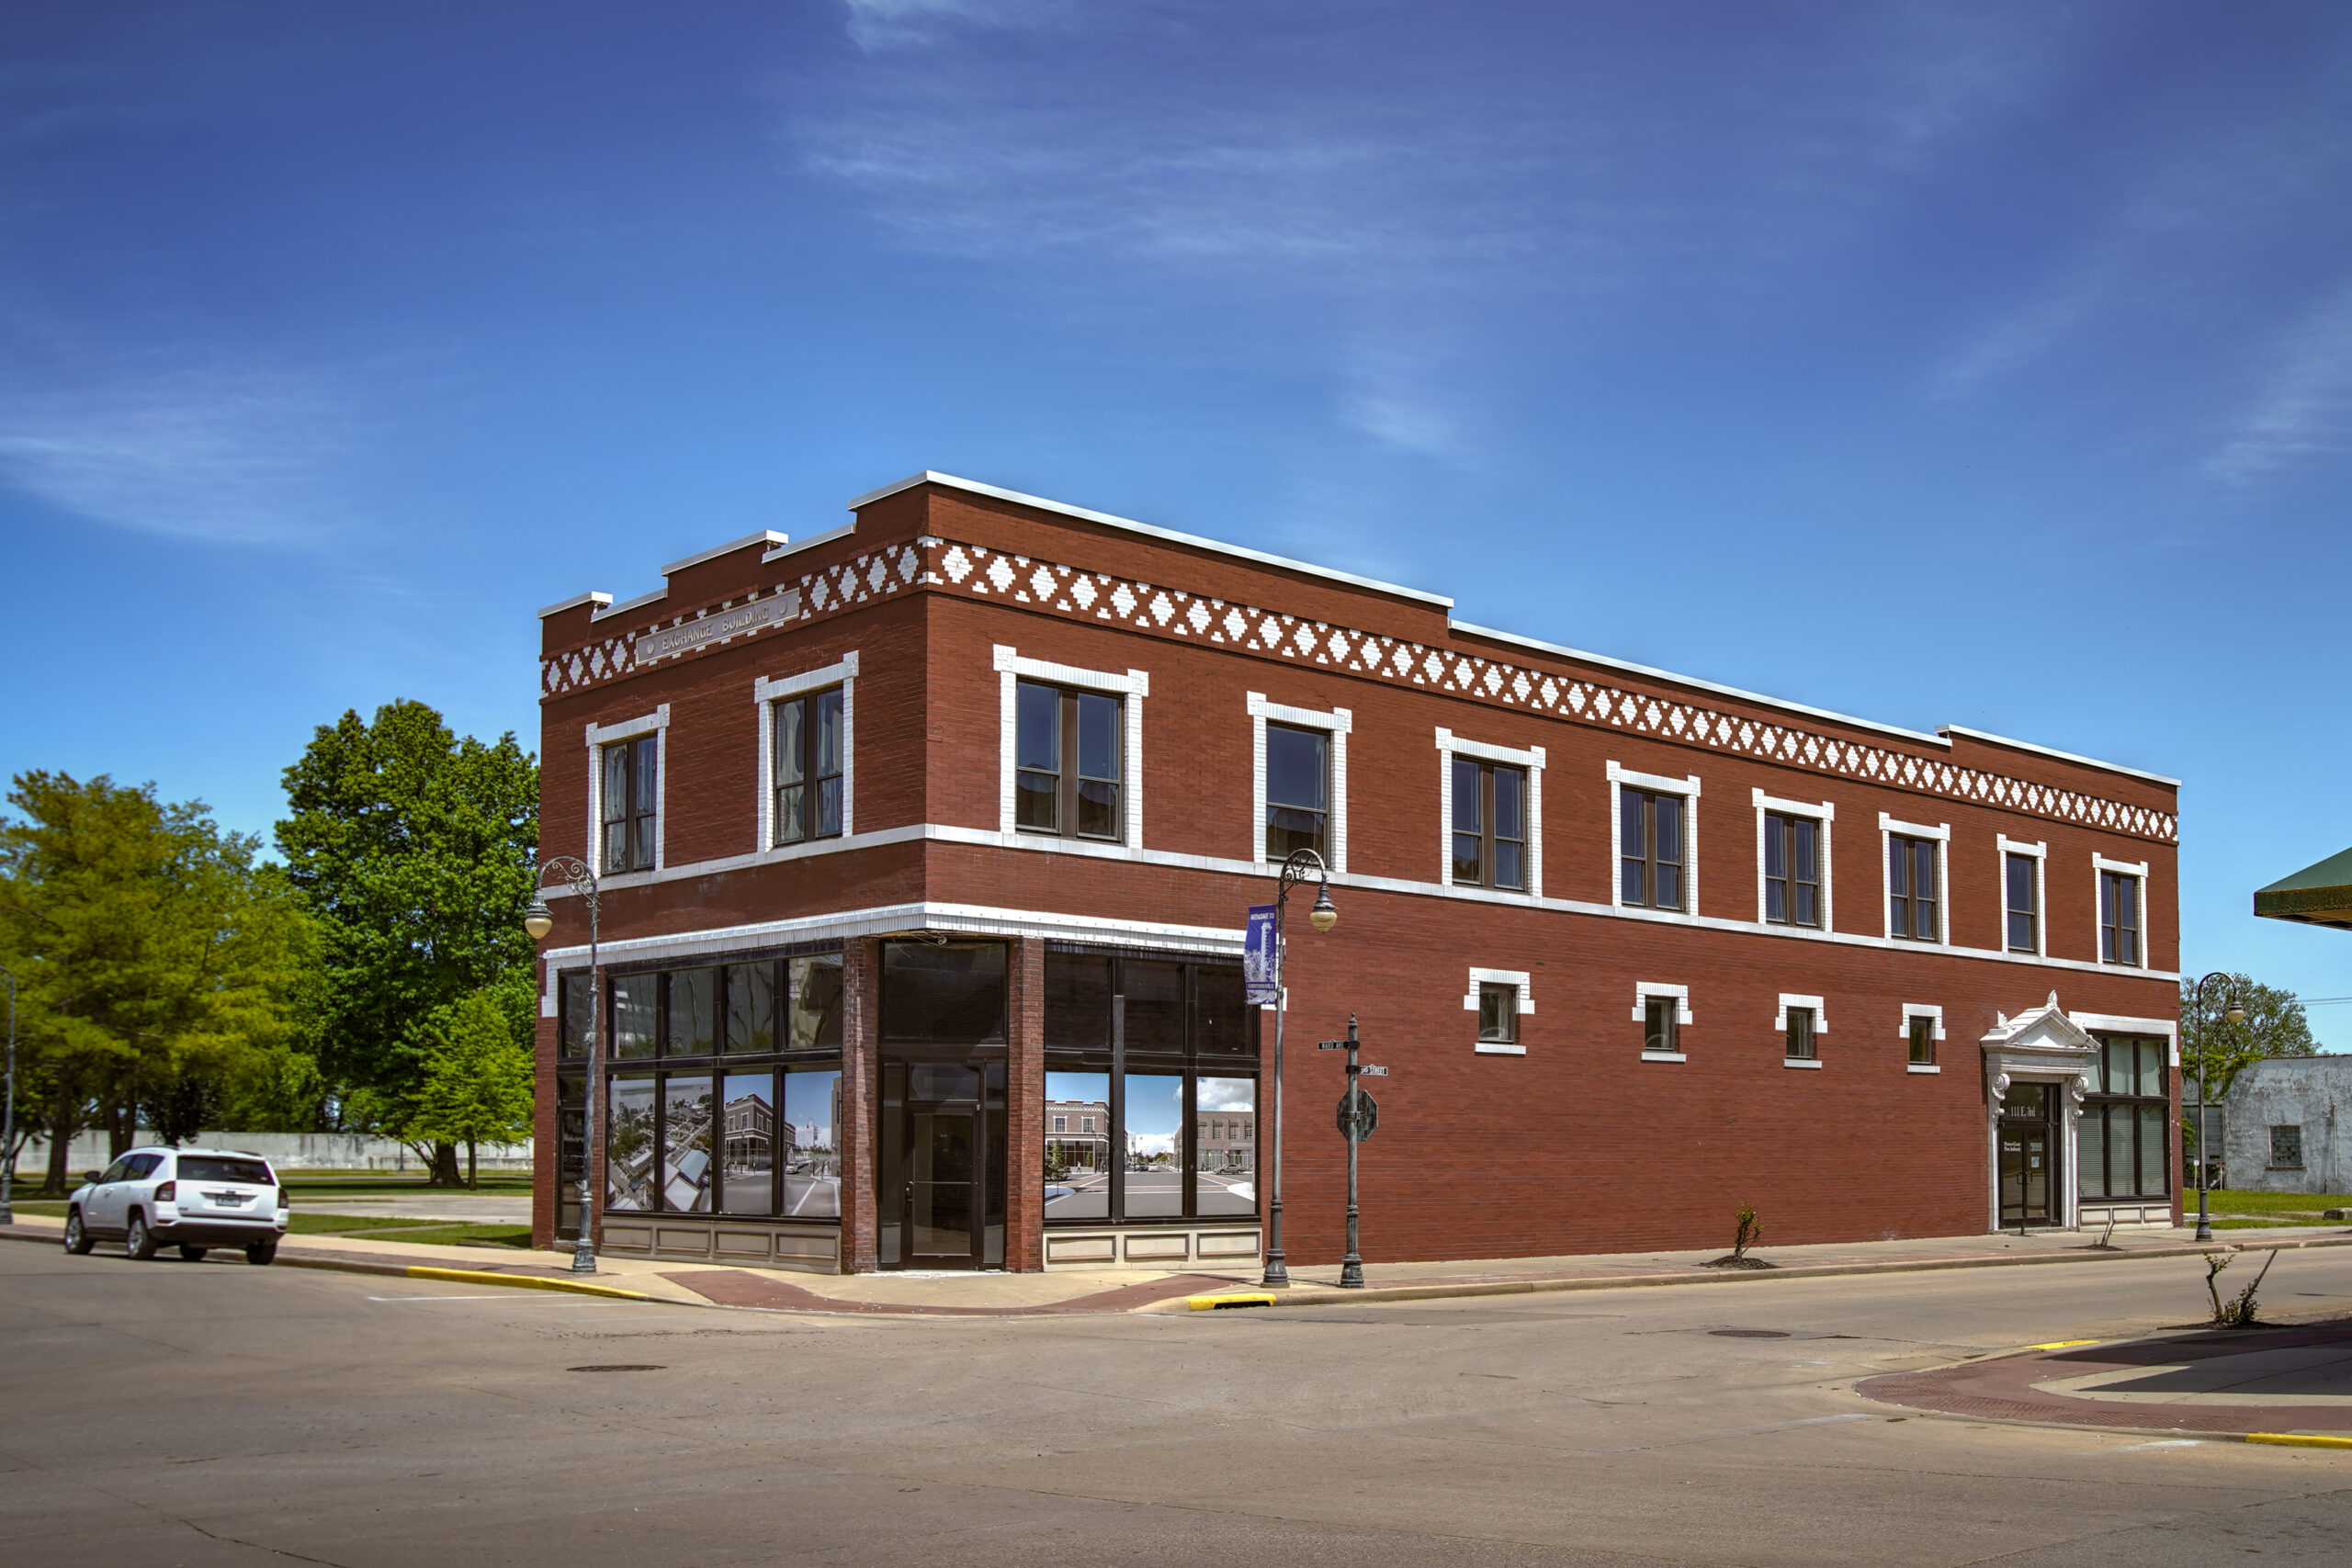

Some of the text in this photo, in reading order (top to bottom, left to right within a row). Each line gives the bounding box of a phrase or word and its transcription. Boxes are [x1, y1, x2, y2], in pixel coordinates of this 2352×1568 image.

[662, 605, 770, 650] EXCHANGE BUILDING
[2011, 1106, 2036, 1117] 111 E 3rd
